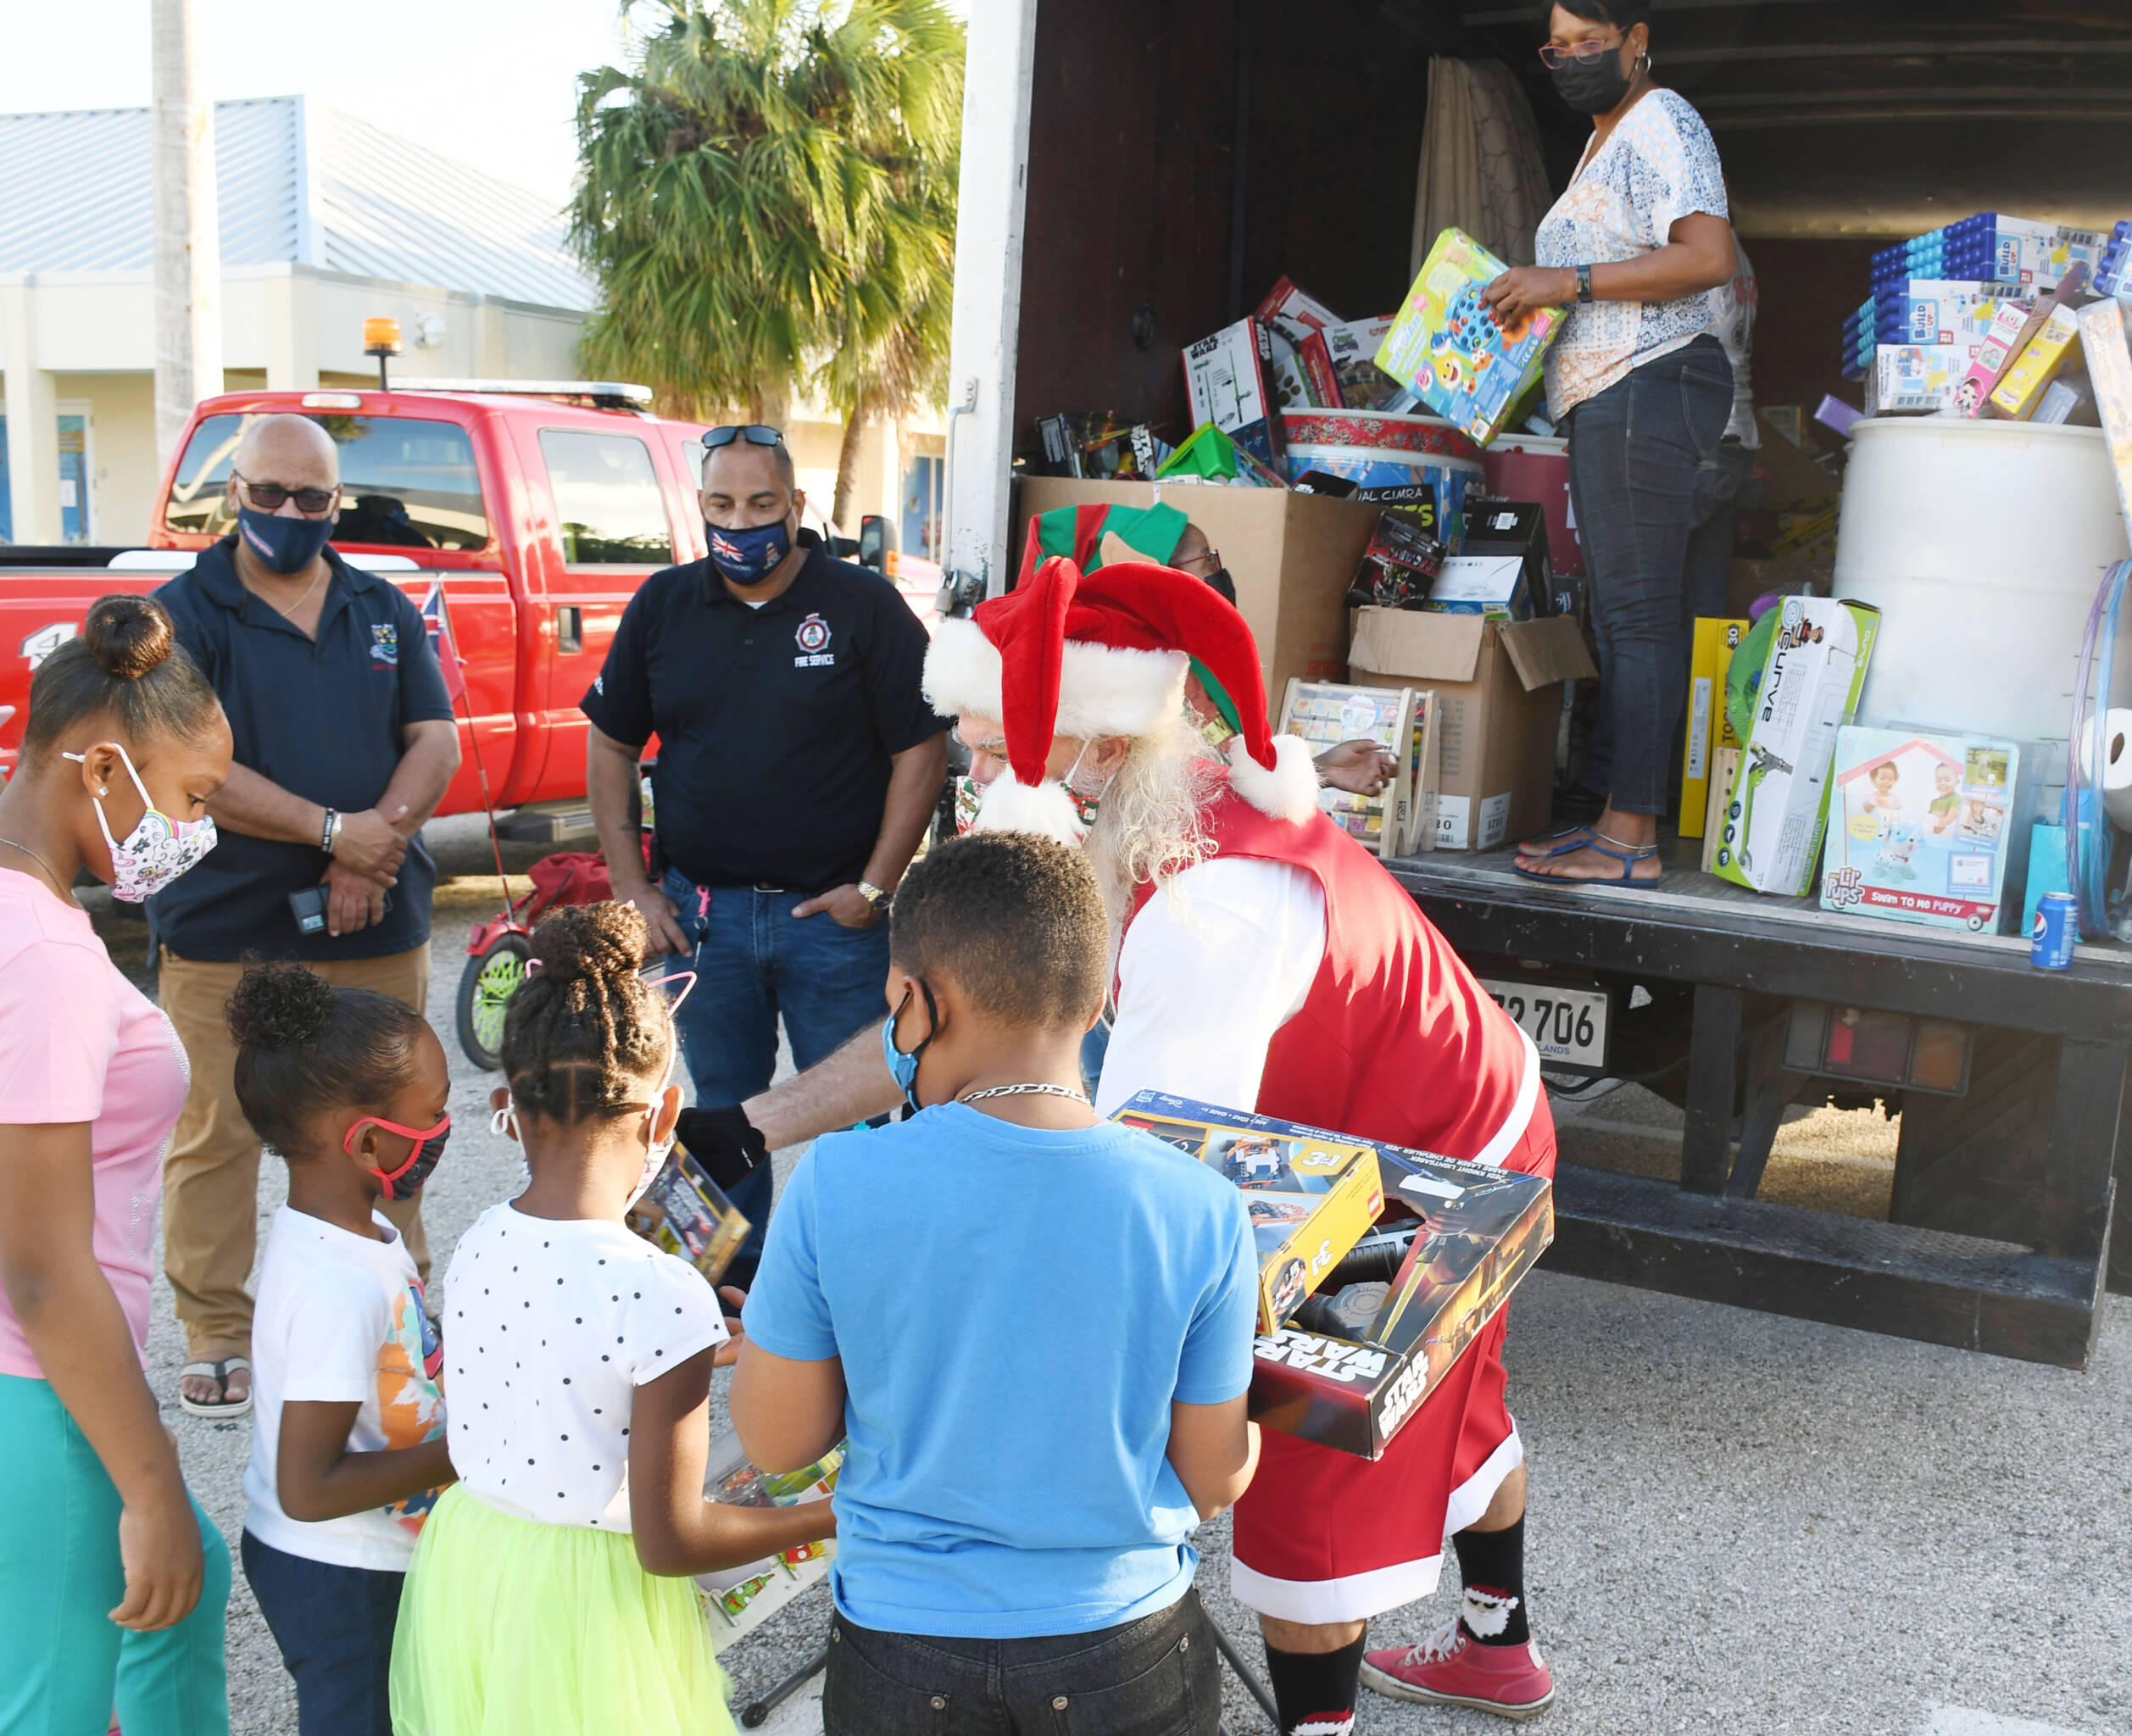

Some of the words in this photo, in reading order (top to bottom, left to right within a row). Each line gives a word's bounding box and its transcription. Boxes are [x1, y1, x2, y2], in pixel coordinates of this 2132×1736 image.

[1190, 341, 1218, 359] WARS
[1728, 627, 1739, 645] 30
[794, 656, 809, 667] FIRE
[809, 654, 834, 666] SERVICE
[1534, 999, 1594, 1048] 706
[1535, 1043, 1571, 1055] LANDS
[1384, 1143, 1403, 1152] JEDI
[1403, 1147, 1443, 1161] CHEVALIER
[1457, 1160, 1482, 1170] LASER
[1457, 1166, 1486, 1177] KNIGHT
[1483, 1164, 1509, 1176] SABRE
[1254, 1340, 1356, 1383] STAR
[1255, 1329, 1388, 1379] WARS
[1383, 1349, 1429, 1410] STAR
[1378, 1370, 1428, 1439] WARS
